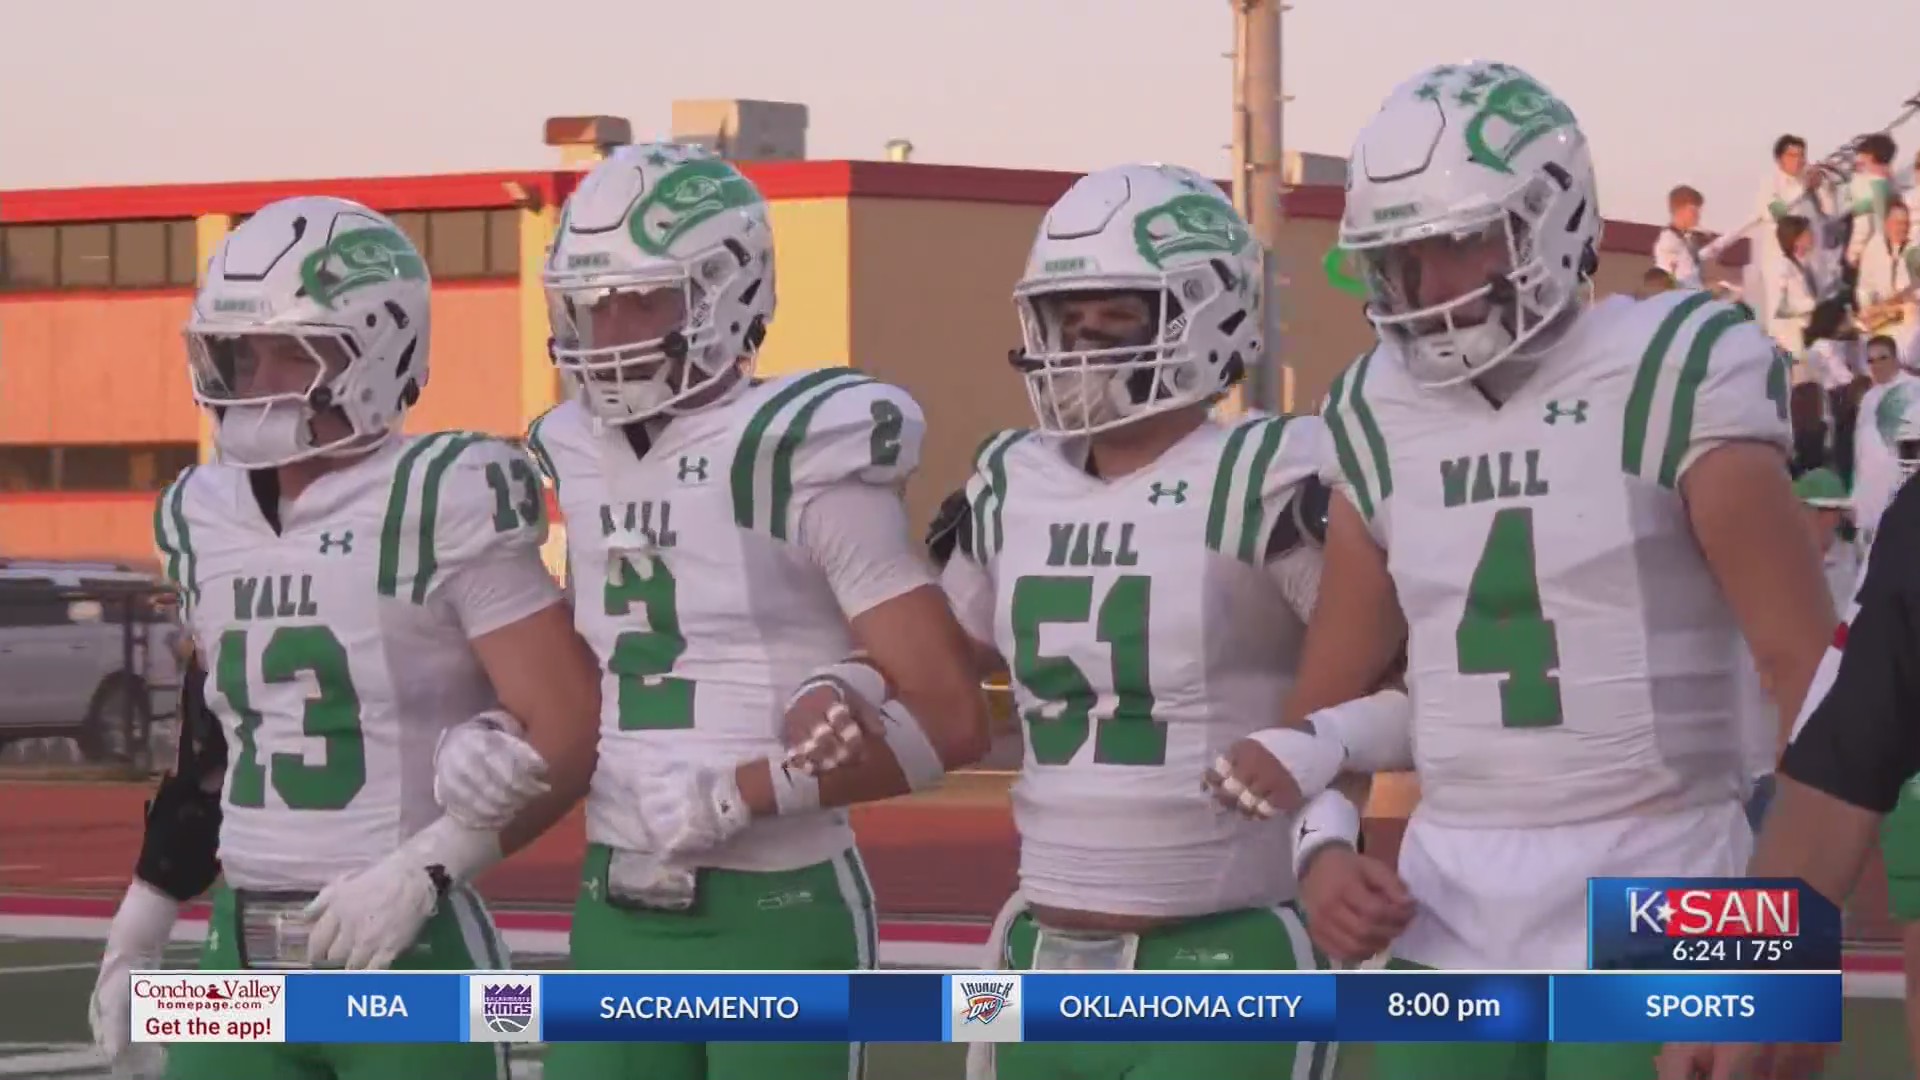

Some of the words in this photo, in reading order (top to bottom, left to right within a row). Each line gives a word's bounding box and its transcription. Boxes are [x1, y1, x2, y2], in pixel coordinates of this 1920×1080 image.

[870, 399, 903, 466] 2
[486, 459, 540, 533] 13
[1440, 450, 1548, 507] WALL
[1046, 522, 1138, 566] WALL
[233, 575, 317, 621] WALL
[1456, 507, 1564, 728] 4
[604, 553, 698, 731] 2
[1011, 575, 1168, 765] 51
[216, 625, 366, 811] 13
